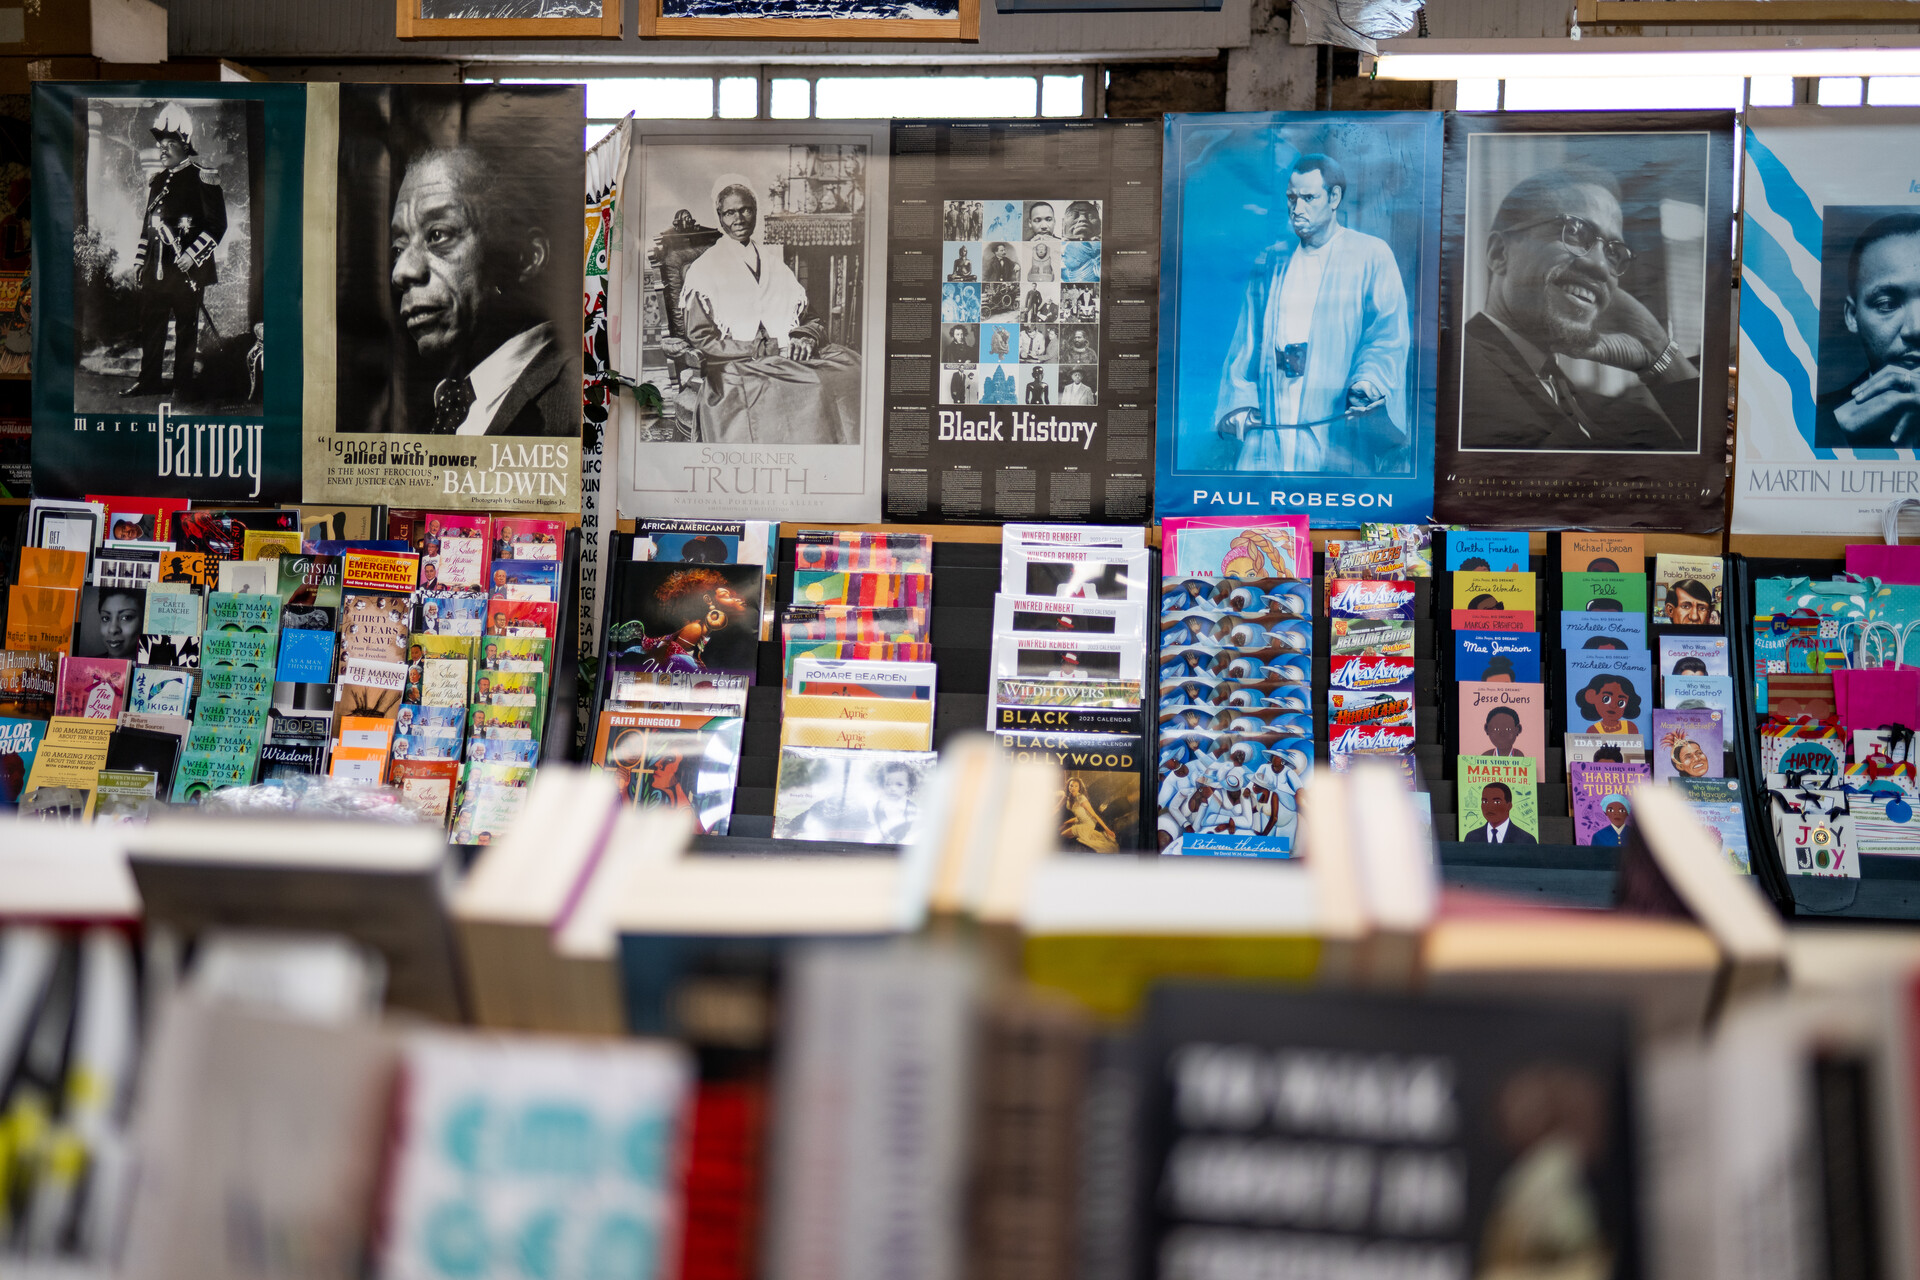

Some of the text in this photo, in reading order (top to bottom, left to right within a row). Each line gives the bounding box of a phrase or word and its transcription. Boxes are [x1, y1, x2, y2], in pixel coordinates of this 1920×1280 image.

[938, 411, 1003, 441] Black
[1011, 411, 1097, 450] History
[158, 402, 263, 498] Garvey
[344, 451, 478, 469] allied with power,
[489, 443, 569, 472] JAMES
[327, 467, 432, 477] IS THE MOST FEROCIOUS
[327, 477, 354, 485] ENEMY
[355, 477, 386, 486] JUSTICE
[388, 478, 407, 486] CAN
[443, 470, 568, 497] BALDWIN
[683, 466, 809, 495] TRUTH
[1530, 479, 1587, 487] studies,
[1593, 479, 1644, 488] history
[1750, 469, 1919, 493] MARTIN LUTHER
[471, 496, 503, 505] Photograph
[513, 497, 535, 505] Chester
[537, 497, 557, 506] Higgins
[558, 498, 566, 506] Jr.
[673, 497, 825, 507] NATIONAL PORTRAIT GALLERY
[1193, 490, 1393, 507] PAUL ROBESON
[641, 522, 740, 533] AFRICAN AMERICAN ART
[49, 530, 60, 544] GET
[1488, 541, 1520, 554] Franklin
[1573, 542, 1603, 553] Michael
[1340, 546, 1402, 570] ENGINEERS
[288, 558, 339, 576] CRYSTAL
[348, 560, 410, 573] EMERGENCY
[302, 574, 336, 586] CLEAR
[348, 569, 412, 582] DEPARTMENT
[1663, 571, 1717, 580] Pablo Picasso?
[1465, 583, 1522, 593] Stevie Wonder
[1590, 583, 1617, 596] Pelé
[158, 607, 190, 615] BLANCHE
[216, 602, 273, 612] WHAT MAMA
[1014, 600, 1043, 612] WINFRED
[1044, 602, 1075, 613] REMBERT
[215, 610, 273, 620] USED TO SAY
[352, 614, 387, 623] THIRTY
[364, 625, 398, 635] YEARS
[1464, 621, 1524, 630] MARCUS RASHFORD
[1566, 623, 1641, 633] Michelle Obama
[353, 635, 392, 645] A SLAVE
[1336, 628, 1414, 649] RECYCLING CENTER
[1463, 640, 1531, 655] Mae Jemison
[6, 651, 37, 669] Hombre
[38, 652, 54, 673] Más
[287, 663, 323, 671] THINKETH
[1571, 661, 1647, 672] Michelle Obama
[349, 666, 405, 680] THE MAKING
[806, 671, 907, 682] ROMARE BEARDEN
[352, 674, 399, 687] OF A SLAVE
[711, 679, 742, 687] EGYPT
[97, 688, 111, 700] The
[1003, 683, 1105, 698] WILDFLOWERS
[1692, 689, 1722, 697] Castro?
[88, 699, 111, 712] Luxe
[1473, 692, 1530, 706] Jesse Owens
[147, 702, 179, 712] IKIGAI
[838, 707, 869, 720] Annie
[1334, 697, 1409, 725] HURRICANES
[610, 716, 681, 727] FAITH RINGGOLD
[1003, 710, 1069, 725] BLACK
[0, 737, 36, 755] RUCK
[1574, 739, 1642, 748] IDA B. WELLS
[84, 753, 106, 761] FACTS
[262, 747, 314, 762] Wisdom
[1003, 751, 1133, 768] HOLLYWOOD
[1785, 752, 1832, 769] HAPPY
[1467, 765, 1528, 777] MARTIN
[1518, 777, 1531, 786] JR.
[1581, 772, 1645, 785] HARRIET
[1701, 791, 1727, 799] Navajo
[1191, 836, 1281, 853] Between the Lines
